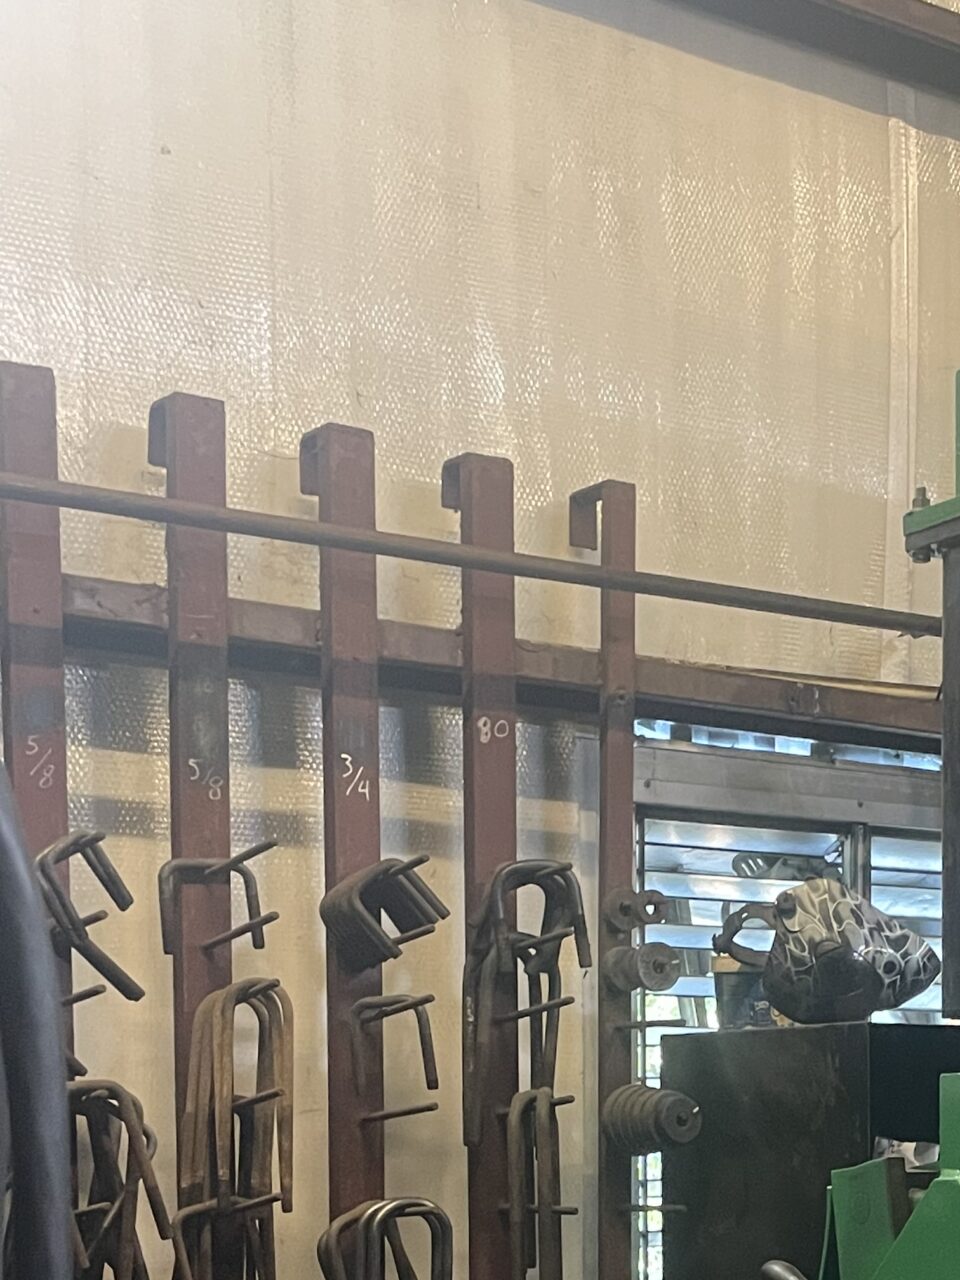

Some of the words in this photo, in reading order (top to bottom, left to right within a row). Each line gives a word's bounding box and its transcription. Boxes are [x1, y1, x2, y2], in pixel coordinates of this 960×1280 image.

[477, 716, 509, 744] 80
[25, 734, 55, 789] 5/8
[188, 758, 224, 800] 5/8
[340, 753, 370, 802] 3/4
